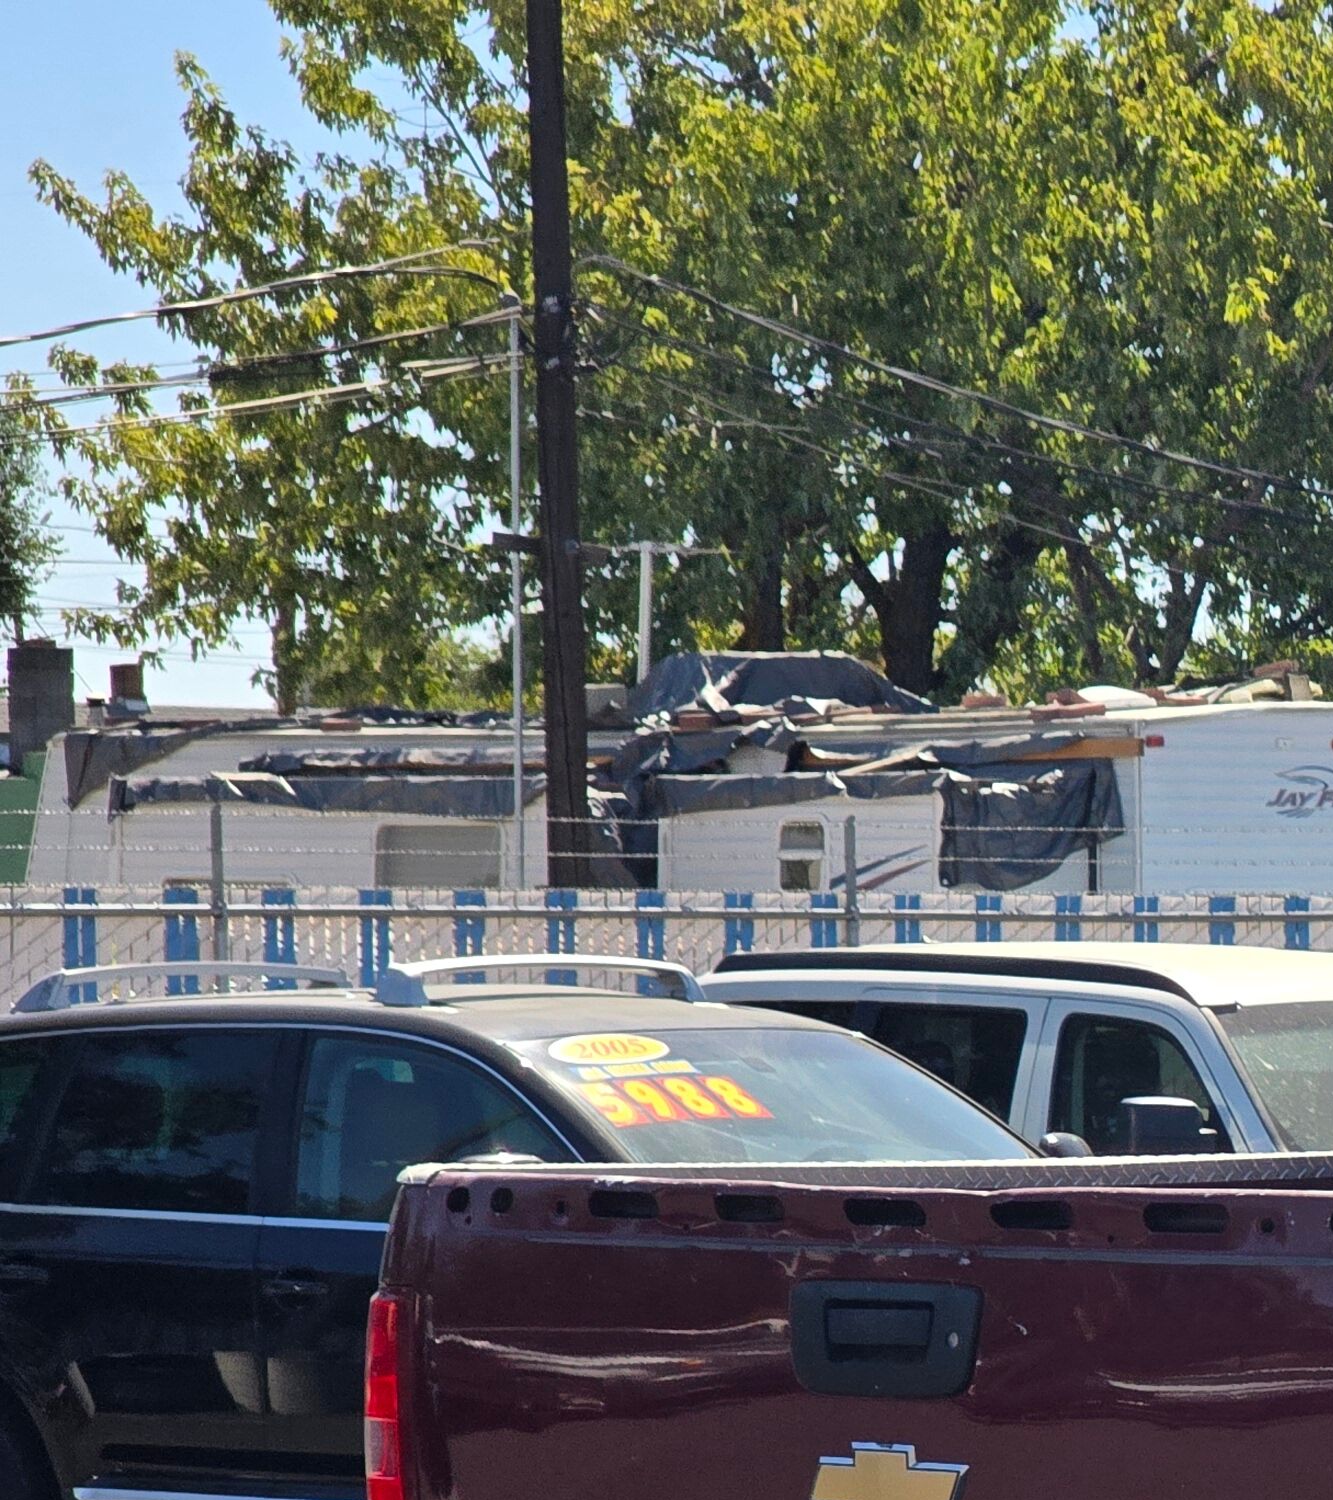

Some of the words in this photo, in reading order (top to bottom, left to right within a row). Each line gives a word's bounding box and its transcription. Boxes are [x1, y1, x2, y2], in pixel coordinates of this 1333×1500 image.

[1265, 788, 1314, 807] JAY
[574, 1038, 648, 1059] 2005
[579, 1076, 760, 1126] 5988
